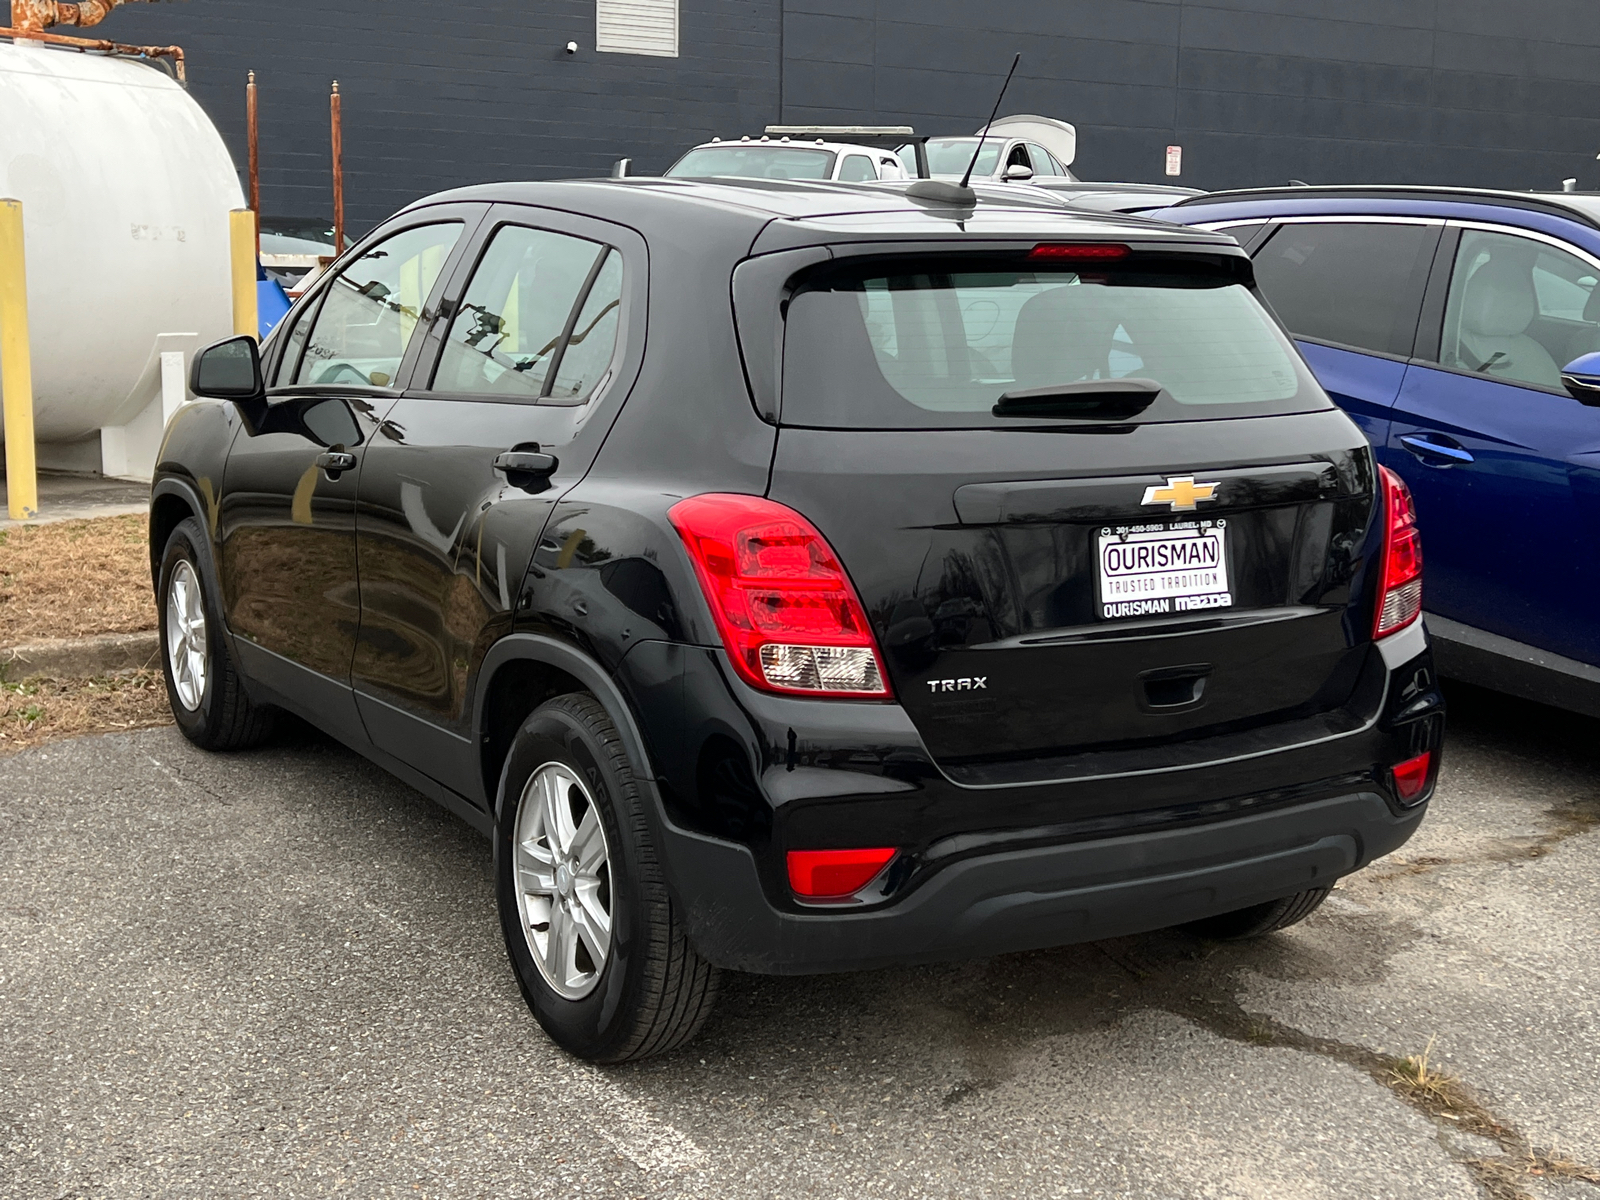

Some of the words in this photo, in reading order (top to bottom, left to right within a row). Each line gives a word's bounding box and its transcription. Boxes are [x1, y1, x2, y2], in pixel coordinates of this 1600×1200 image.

[1116, 523, 1164, 534] 301-450-5903
[1200, 520, 1212, 528] MD
[1107, 541, 1215, 571] OURISMAN
[1108, 578, 1155, 594] TRUSTED
[1161, 573, 1218, 589] TRADITION
[1103, 598, 1169, 618] OURISMAN
[926, 676, 987, 693] TRAX
